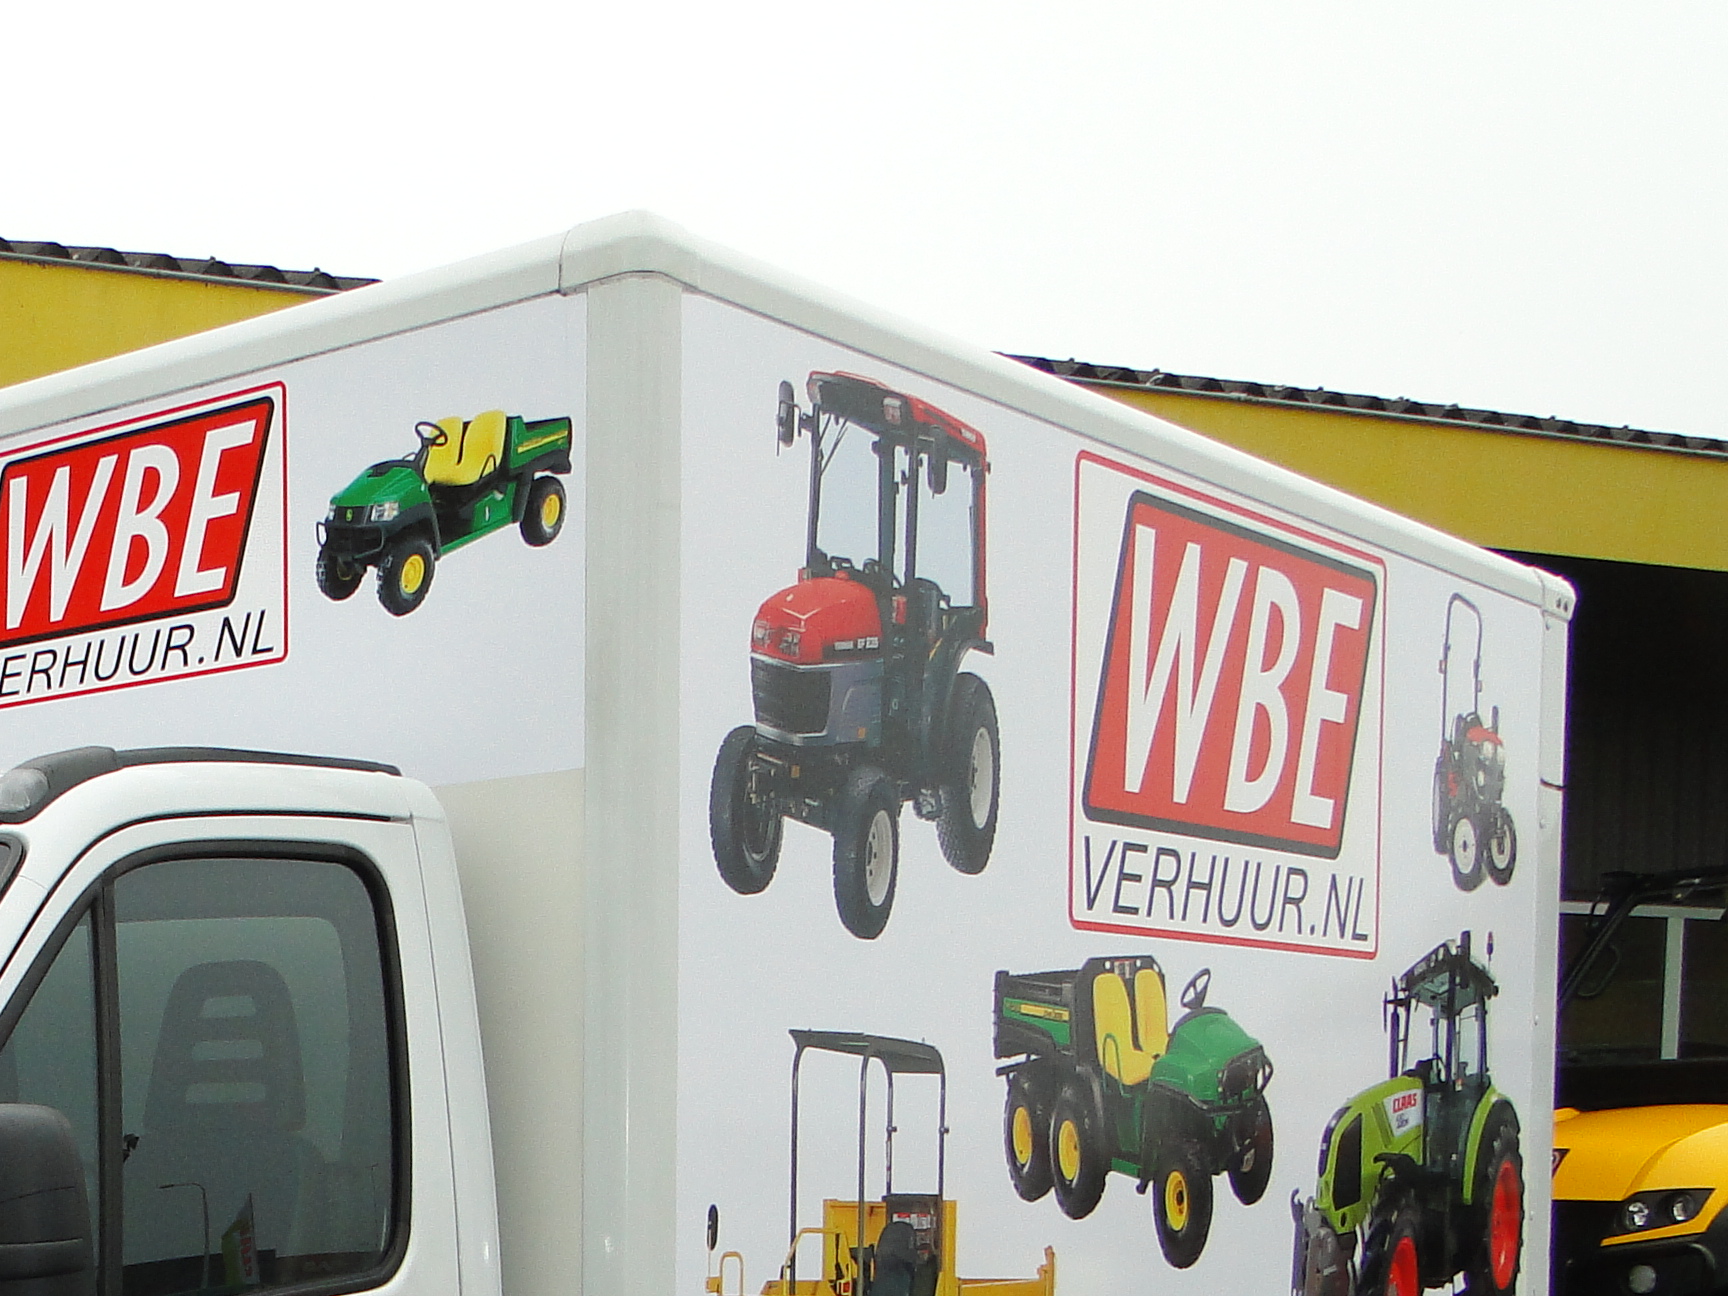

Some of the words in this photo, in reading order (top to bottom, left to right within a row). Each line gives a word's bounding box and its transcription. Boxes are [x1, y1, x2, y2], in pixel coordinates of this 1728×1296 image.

[6, 419, 258, 630] WBE
[1124, 523, 1363, 830] WBE
[1082, 835, 1370, 942] VERHUUR.NL
